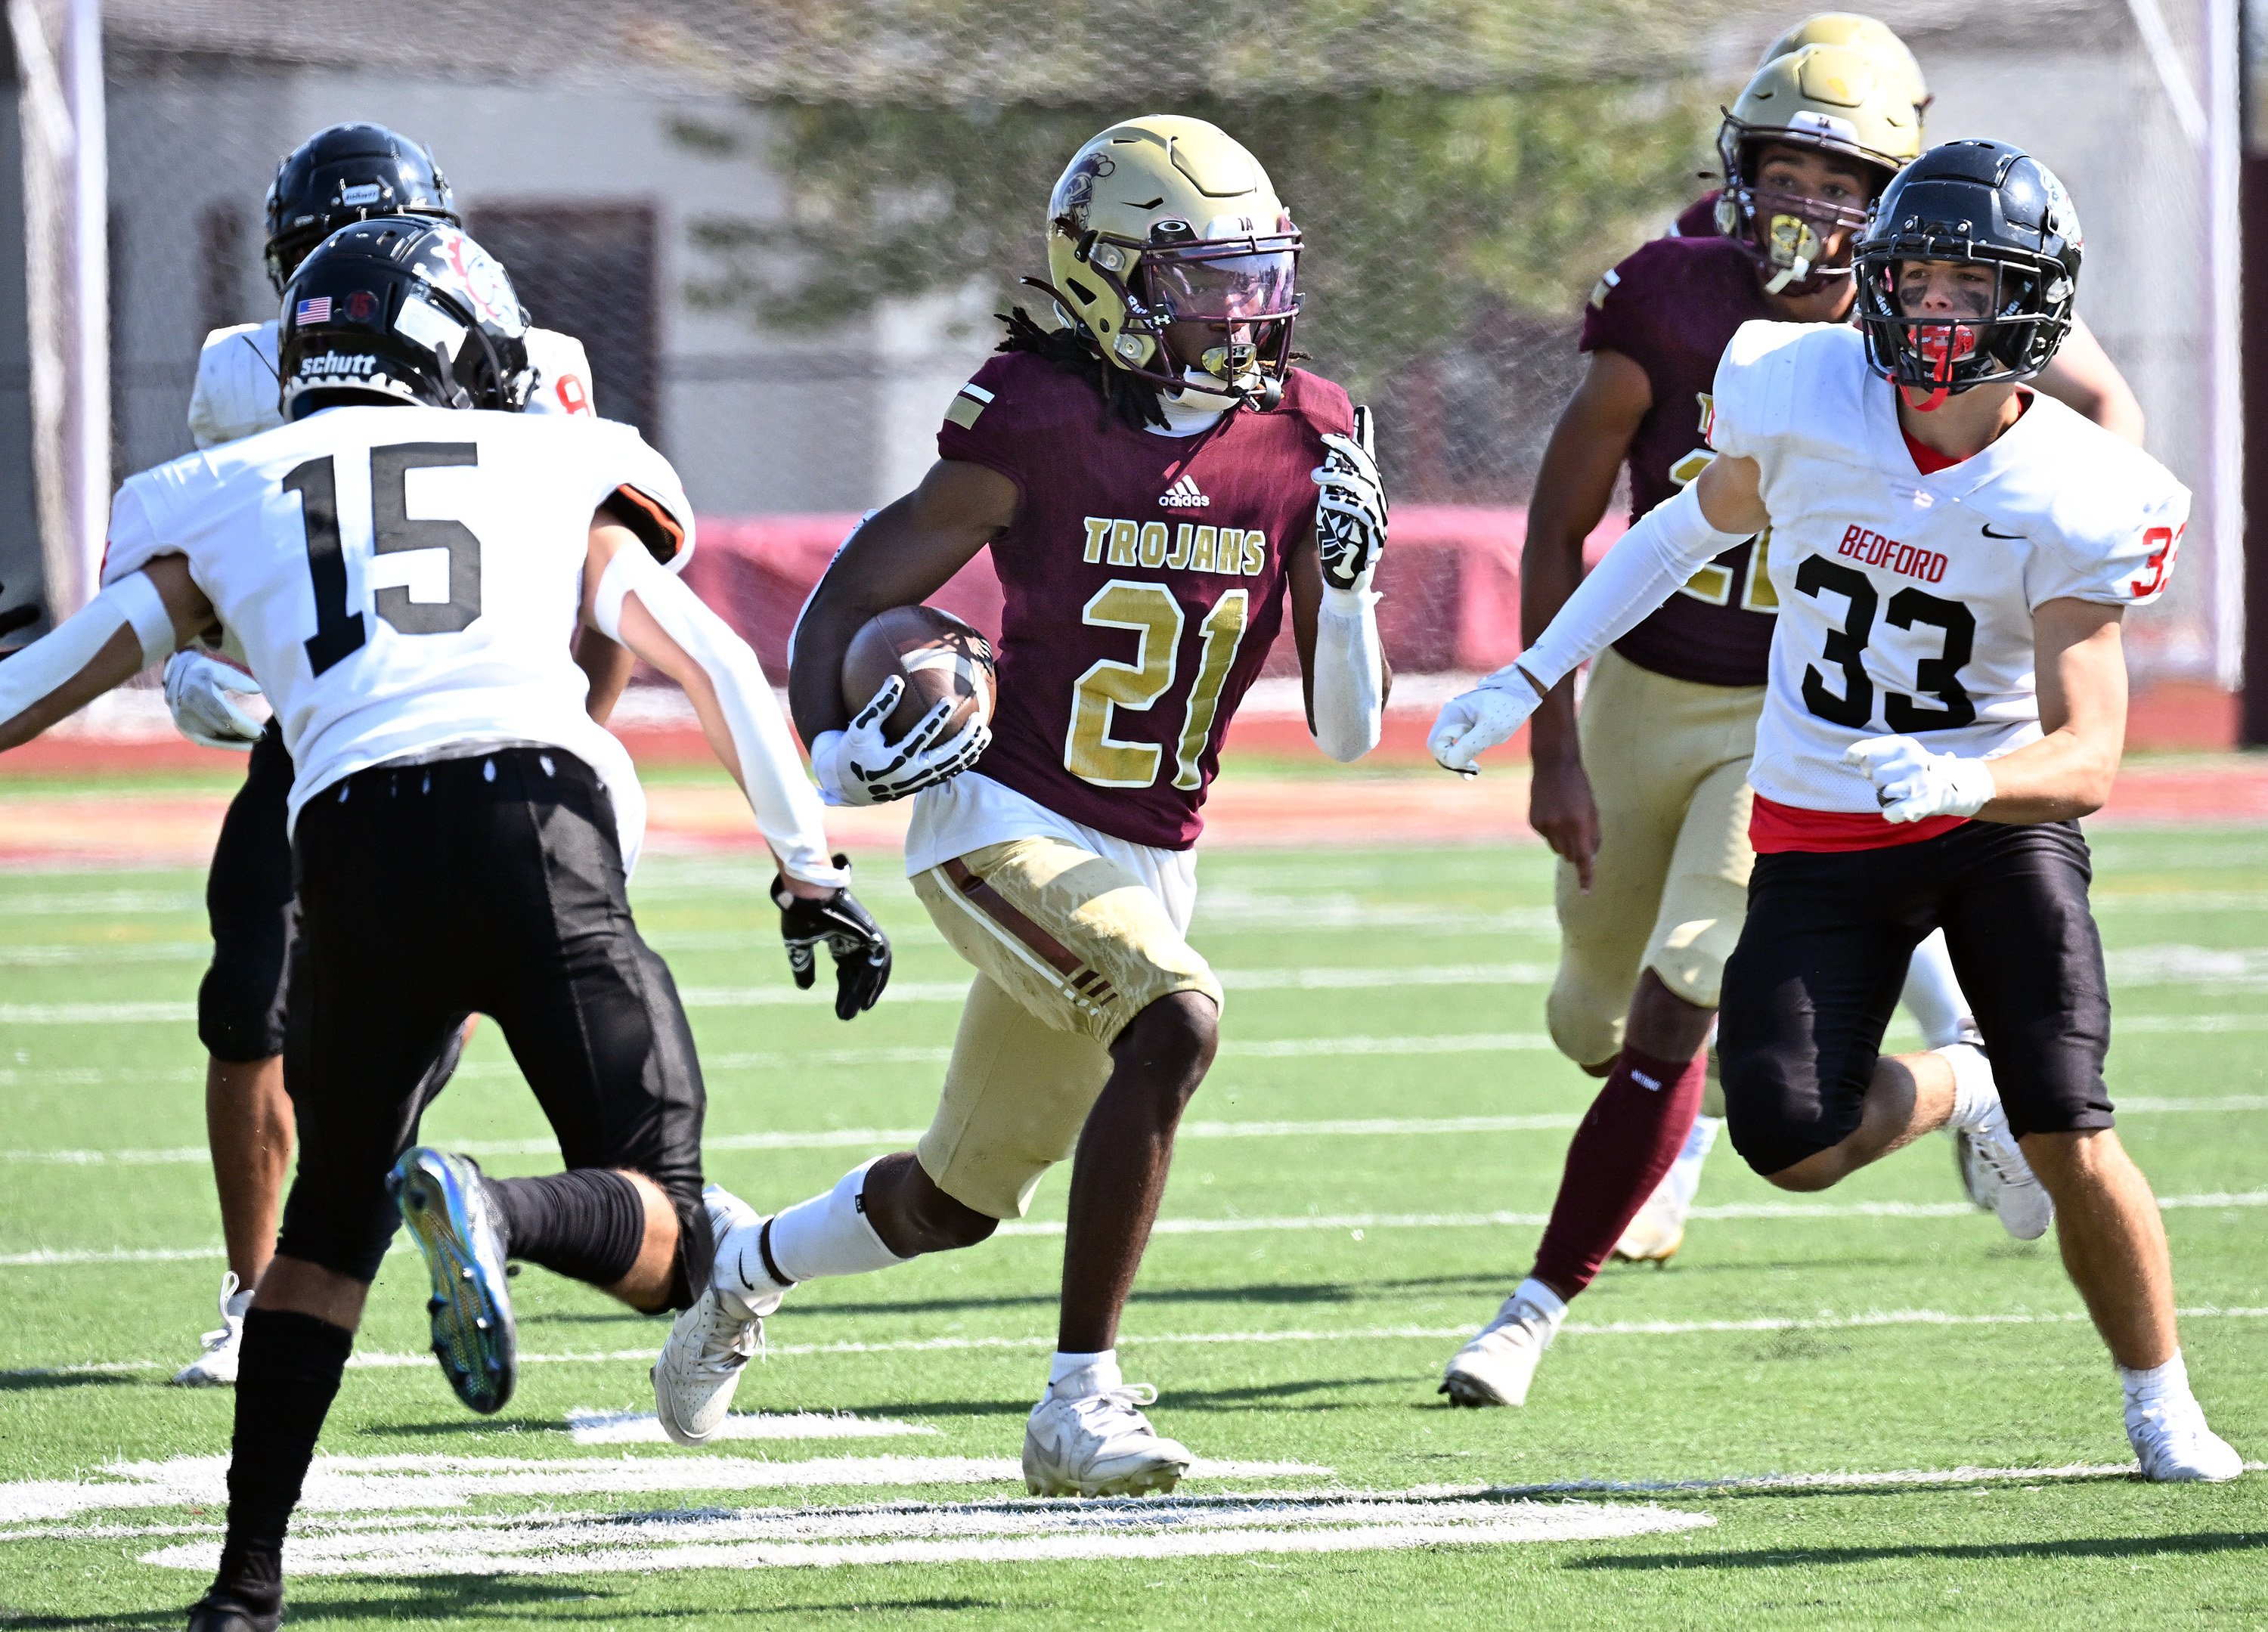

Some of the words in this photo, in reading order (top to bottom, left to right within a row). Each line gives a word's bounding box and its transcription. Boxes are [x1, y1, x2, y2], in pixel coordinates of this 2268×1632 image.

[300, 350, 376, 376] schutt
[1158, 494, 1210, 507] adidas
[282, 441, 482, 679] 15
[1083, 516, 1266, 576] TROJANS
[1838, 524, 1948, 584] BEDFORD
[1795, 553, 1976, 734] 33
[1064, 579, 1248, 791] 21
